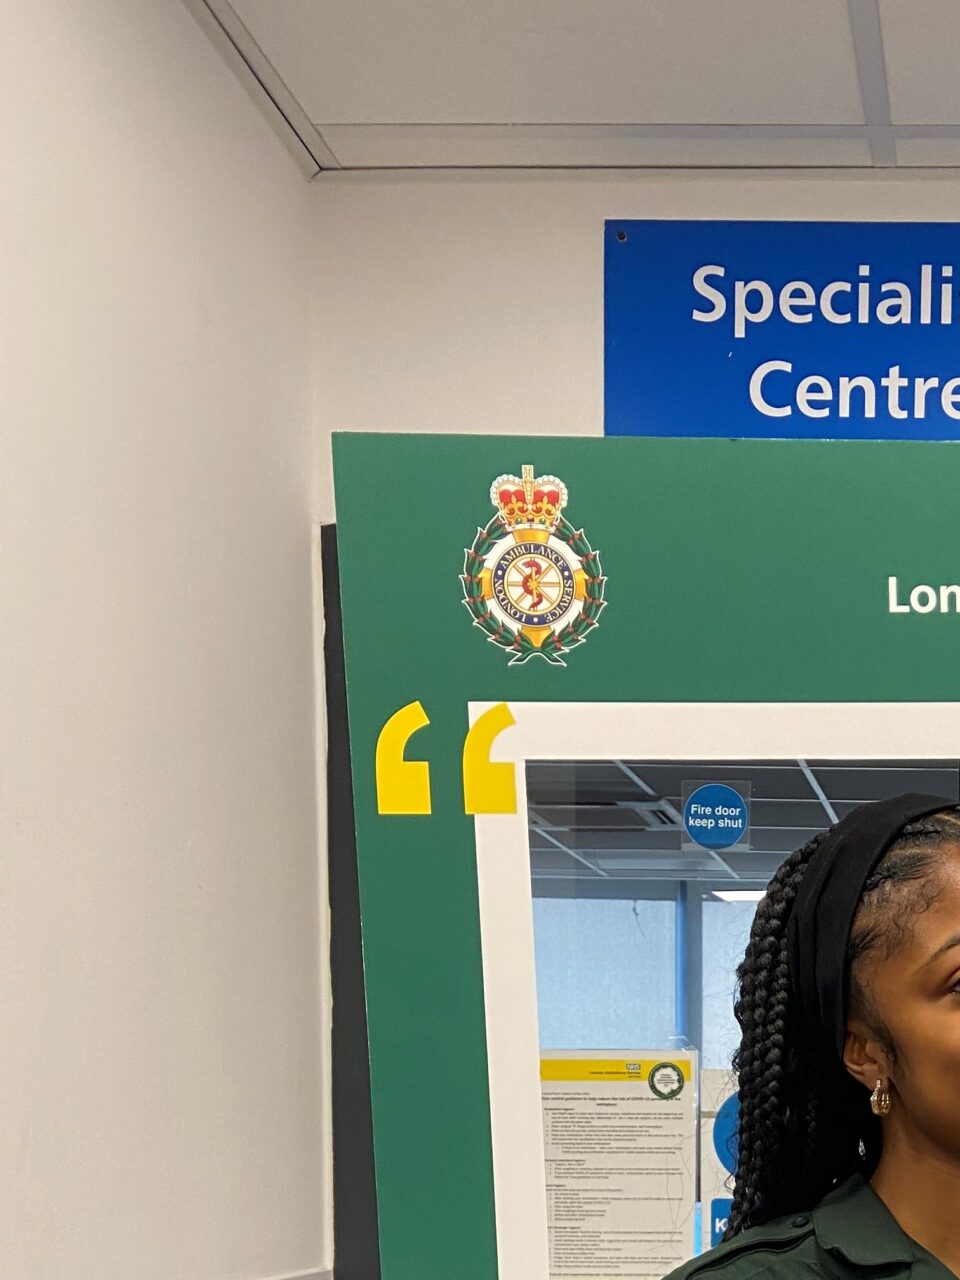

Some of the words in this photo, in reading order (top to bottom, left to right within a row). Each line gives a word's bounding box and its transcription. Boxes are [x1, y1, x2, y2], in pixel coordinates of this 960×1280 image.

[500, 544, 567, 569] AMBULANCE
[495, 579, 526, 622] LONDON
[544, 580, 573, 622] SERVICE
[690, 804, 712, 815] Fire
[714, 805, 741, 816] door
[688, 817, 715, 829] keep
[718, 817, 742, 828] shut
